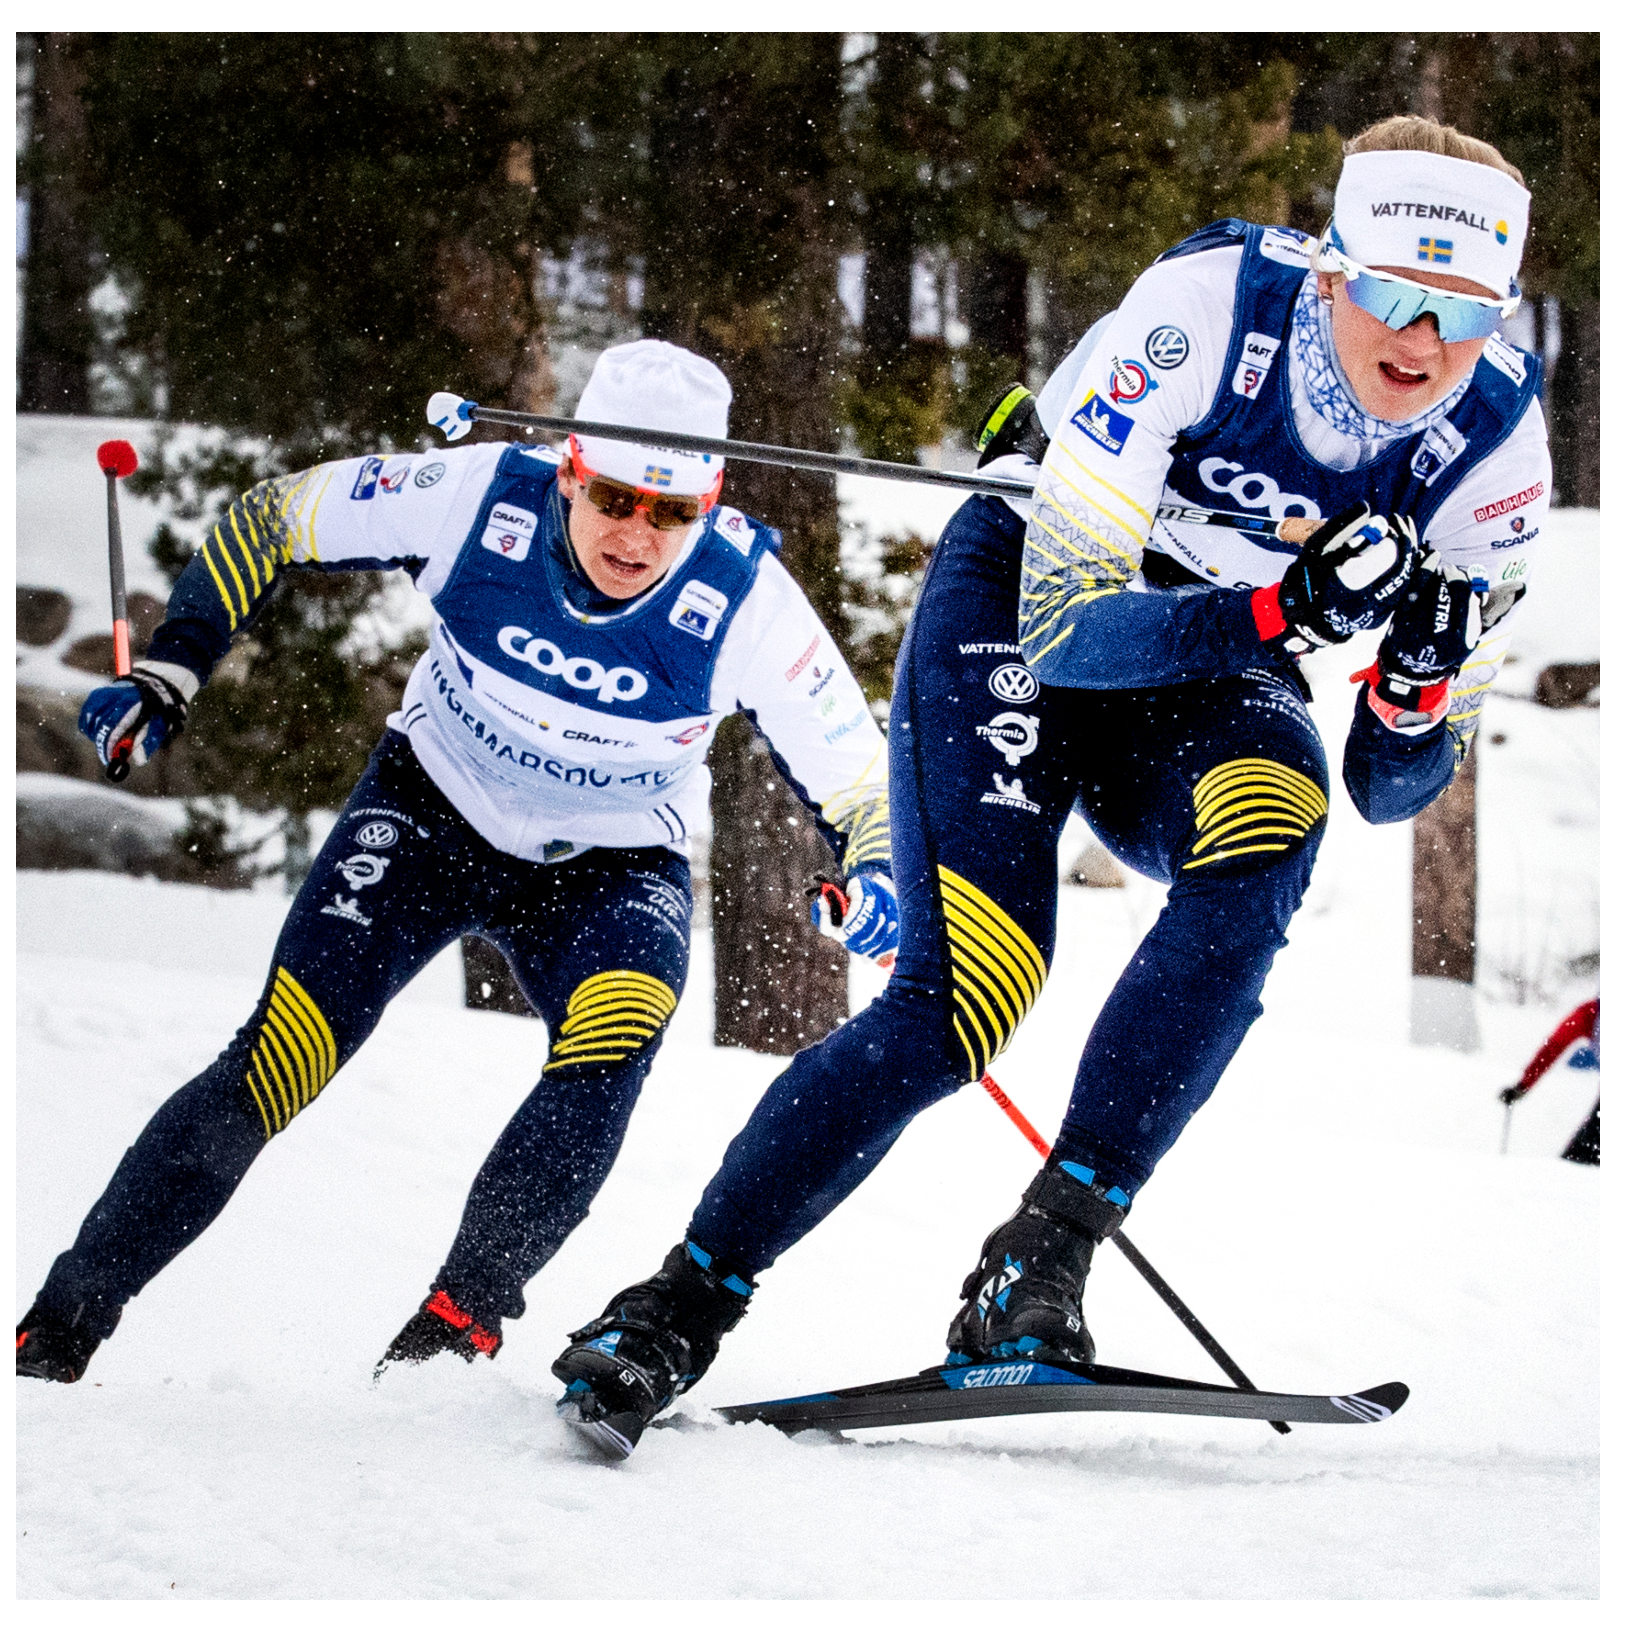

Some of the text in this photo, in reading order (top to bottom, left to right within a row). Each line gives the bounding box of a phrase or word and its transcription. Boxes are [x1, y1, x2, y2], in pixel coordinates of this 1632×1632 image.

[1370, 201, 1490, 232] VATTENFALL
[1110, 355, 1137, 392] Thermia
[1072, 413, 1123, 452] MICHELIN
[1474, 481, 1545, 522] BAUHAUS
[493, 510, 526, 526] CRAFT
[1490, 527, 1539, 549] SCANIA
[497, 625, 649, 704] coop
[562, 729, 622, 748] CRAFT
[975, 725, 1025, 741] Thermia
[980, 794, 1042, 815] MICHELIN
